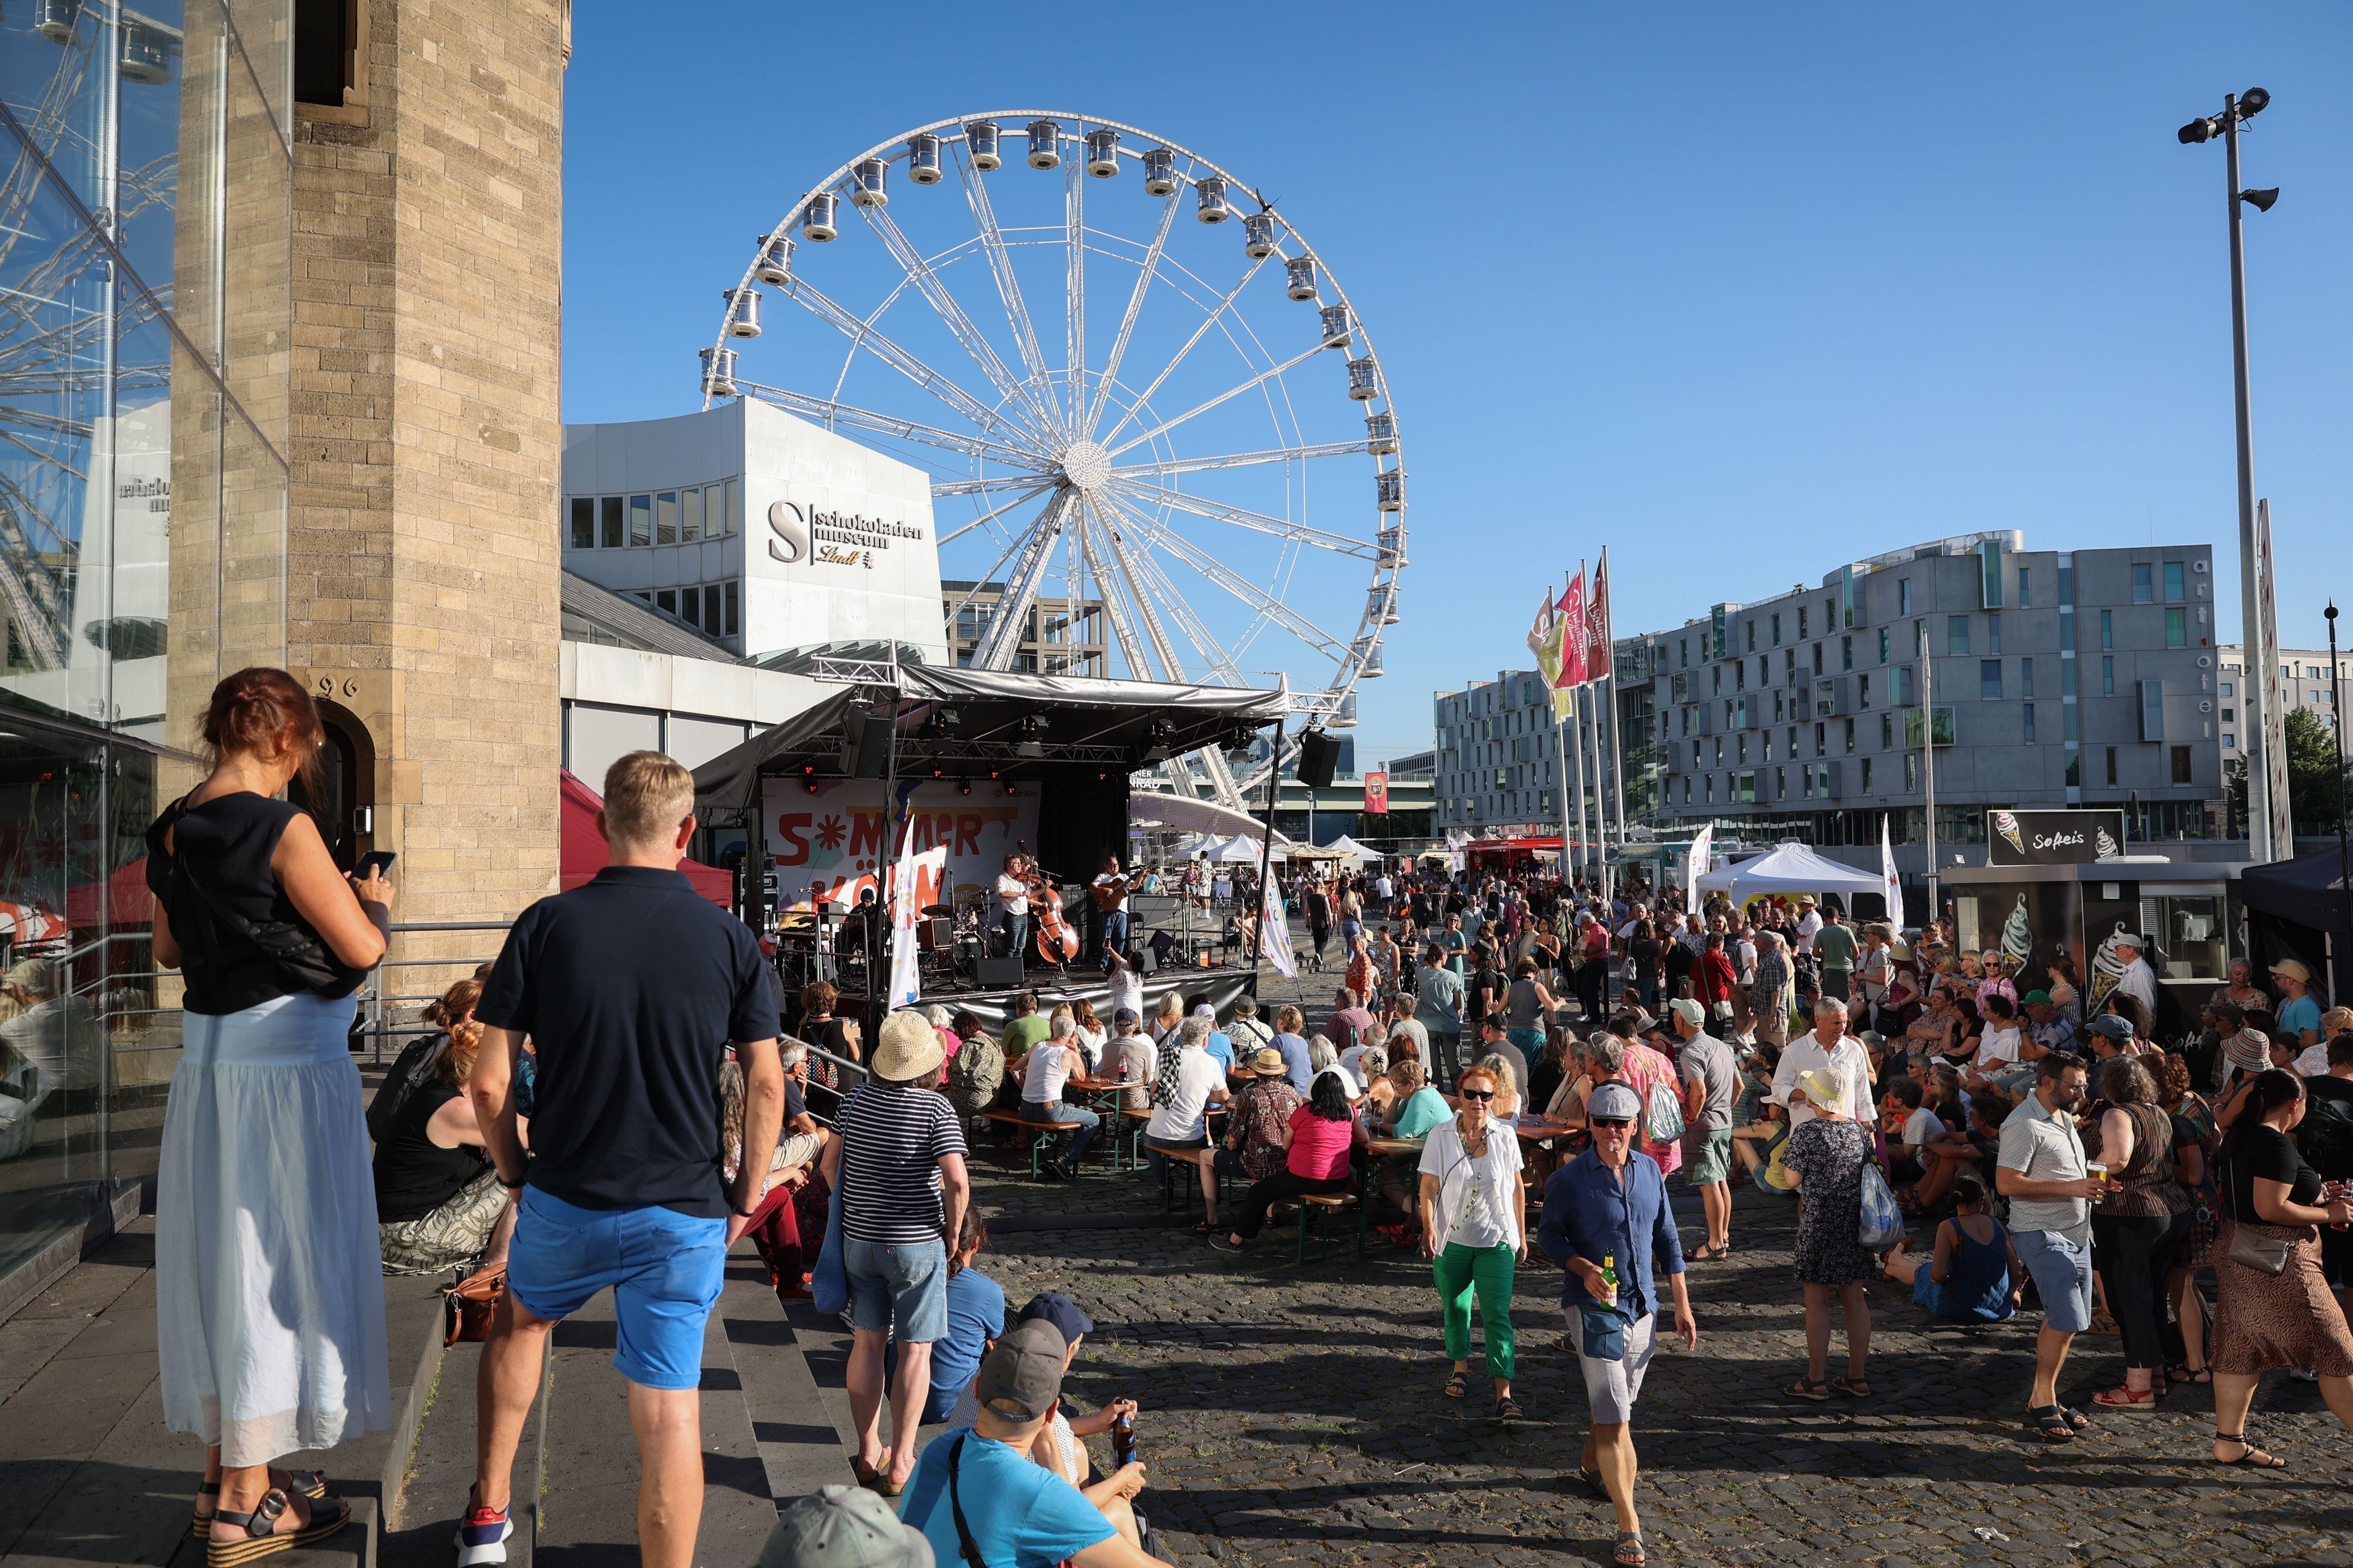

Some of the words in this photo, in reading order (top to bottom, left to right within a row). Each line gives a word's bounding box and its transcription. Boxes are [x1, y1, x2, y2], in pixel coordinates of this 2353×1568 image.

[768, 499, 808, 563] S
[814, 510, 924, 539] schokoladen
[814, 527, 889, 549] museum
[815, 545, 862, 565] Lindt
[2033, 830, 2085, 850] Softeis
[2163, 1030, 2204, 1052] Softe
